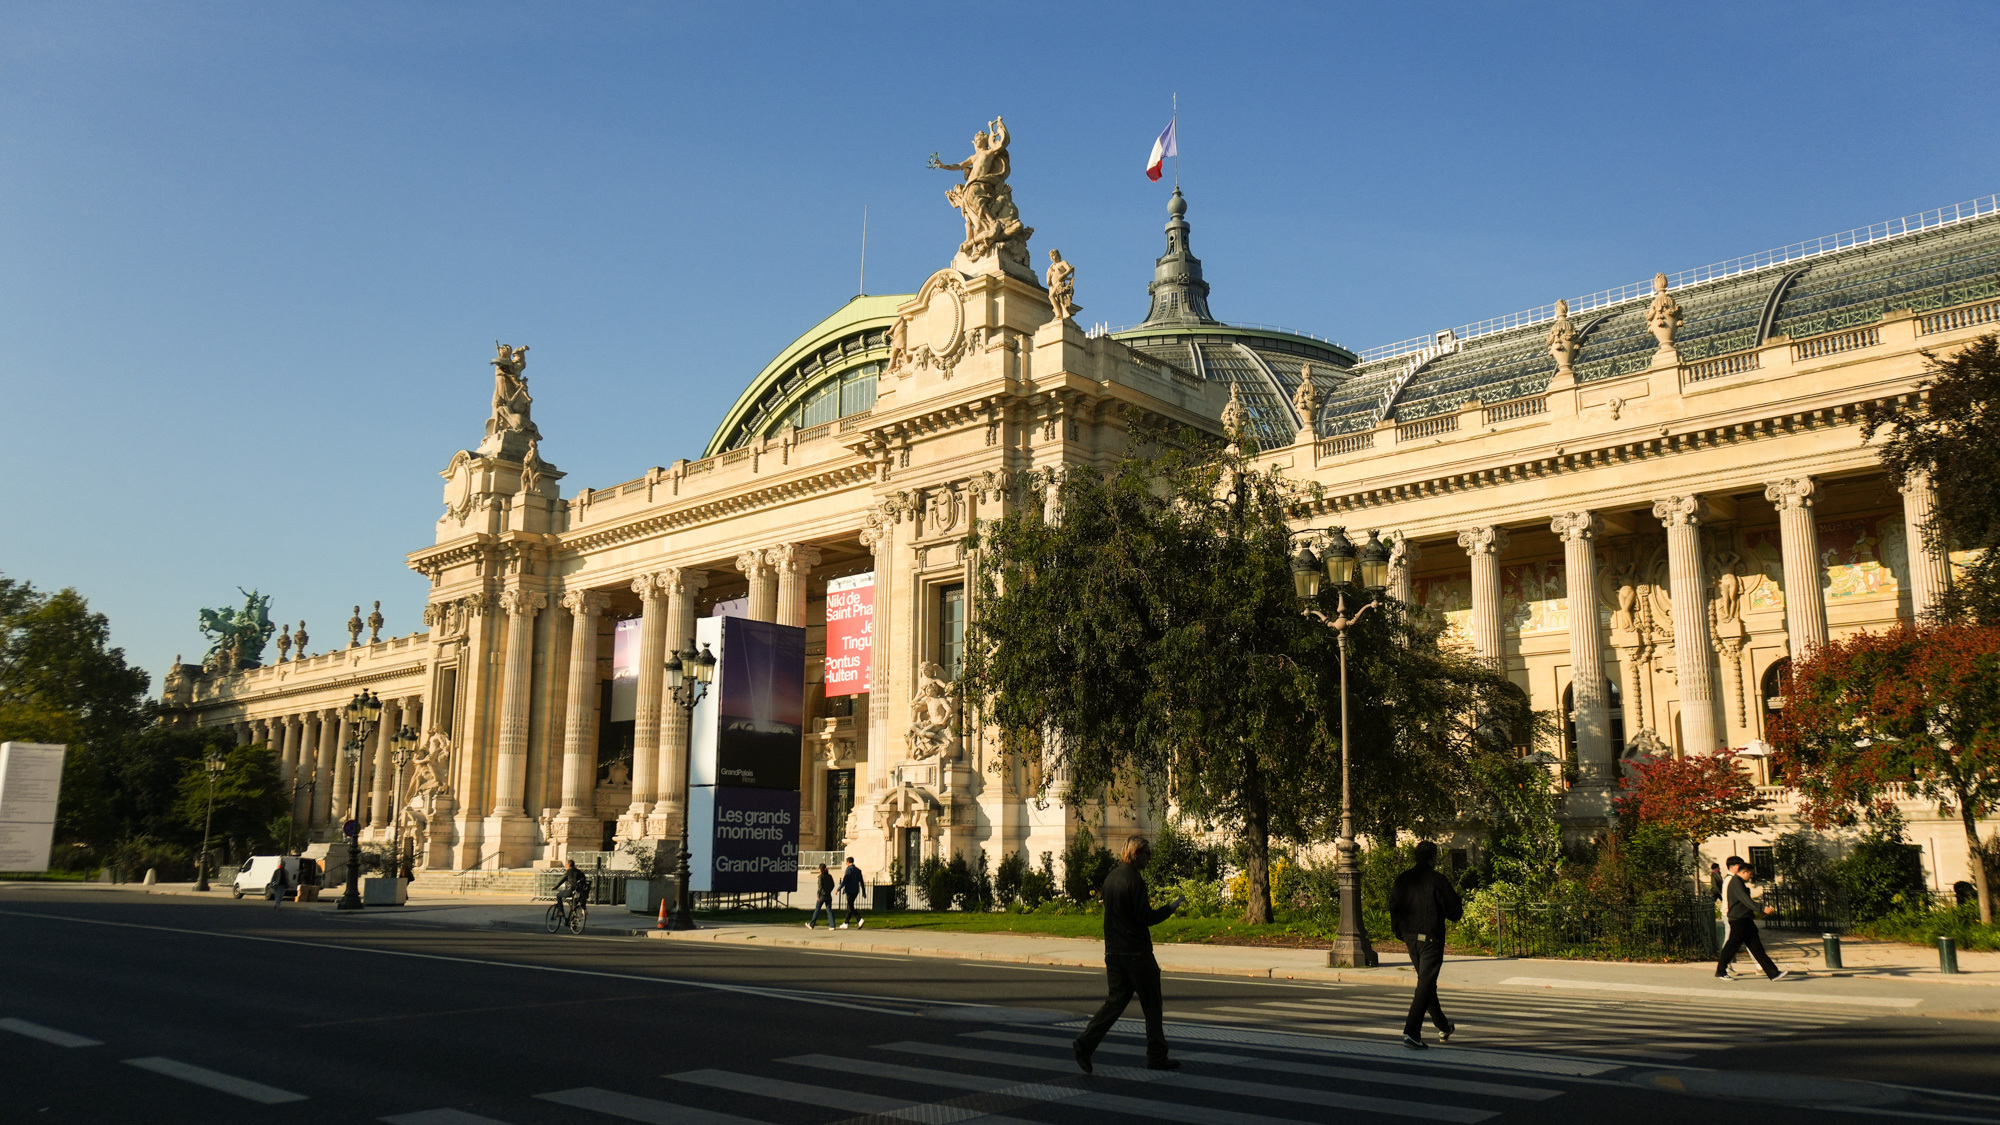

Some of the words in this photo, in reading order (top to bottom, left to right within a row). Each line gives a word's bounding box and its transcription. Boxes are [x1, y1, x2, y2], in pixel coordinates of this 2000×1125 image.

[827, 593, 845, 609] Niki
[846, 591, 860, 605] de
[826, 606, 851, 622] Saint
[825, 655, 860, 670] Pontus
[825, 669, 858, 683] Hulten
[718, 806, 743, 823] Les
[745, 809, 791, 826] grands
[717, 825, 783, 840] moments
[782, 841, 798, 856] du
[716, 856, 759, 872] Grand
[760, 857, 798, 872] Palais
